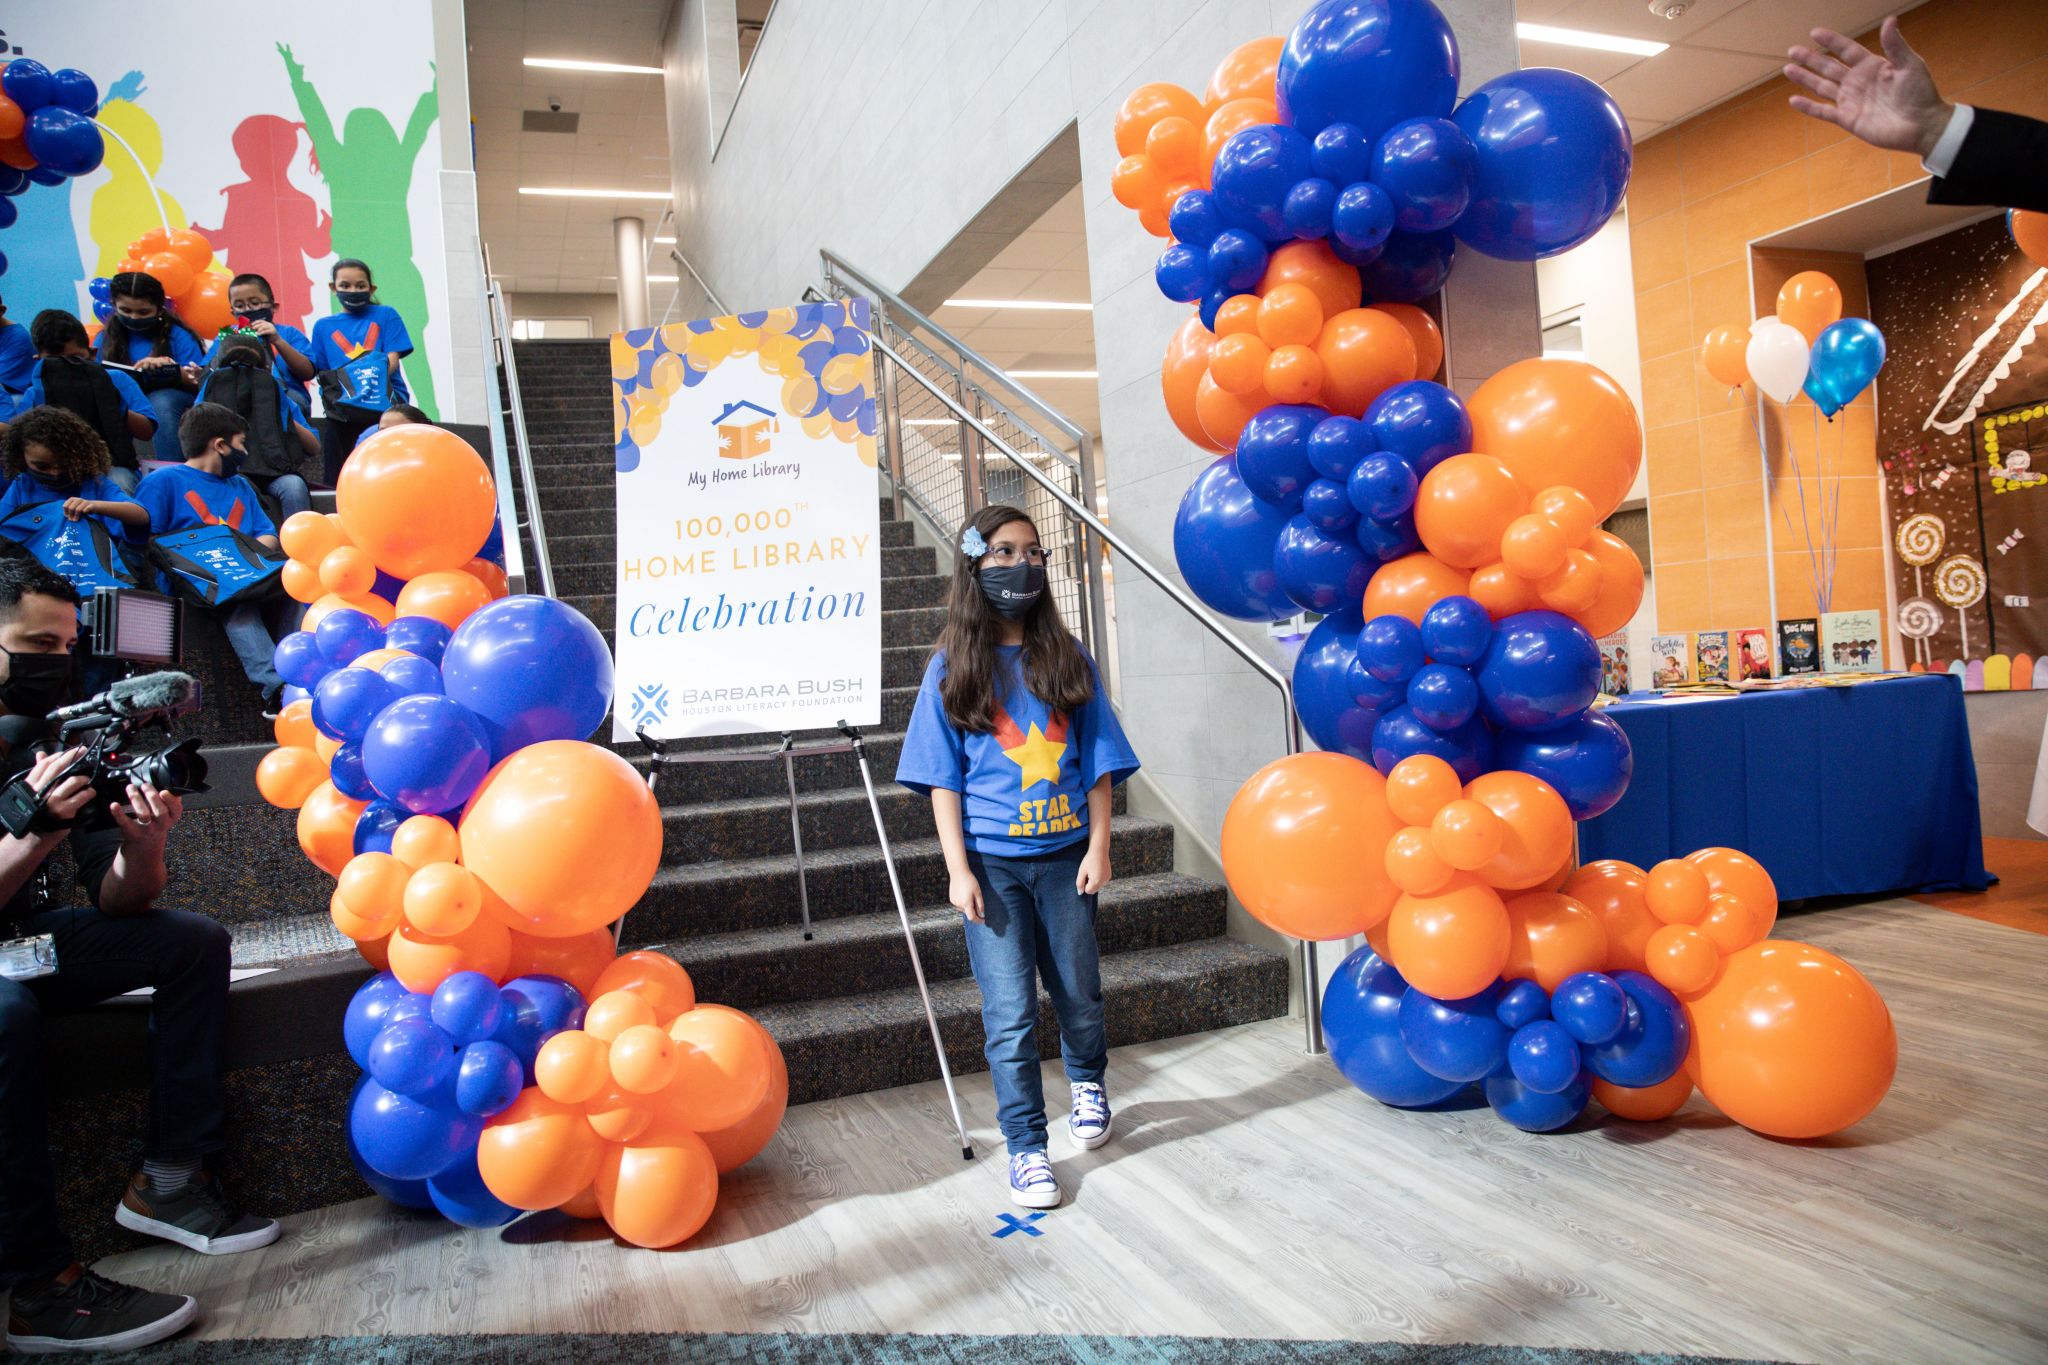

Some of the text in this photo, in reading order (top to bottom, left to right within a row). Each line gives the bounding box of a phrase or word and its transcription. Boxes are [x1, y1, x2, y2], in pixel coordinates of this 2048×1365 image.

[687, 460, 801, 491] My Home Library
[624, 534, 870, 582] HOME LIBRARY
[629, 586, 866, 638] Celebration
[682, 677, 863, 704] BARBARA BUSH
[682, 695, 863, 716] HOUSTON LITERACY FOUNDATION
[1018, 793, 1071, 823] STAR
